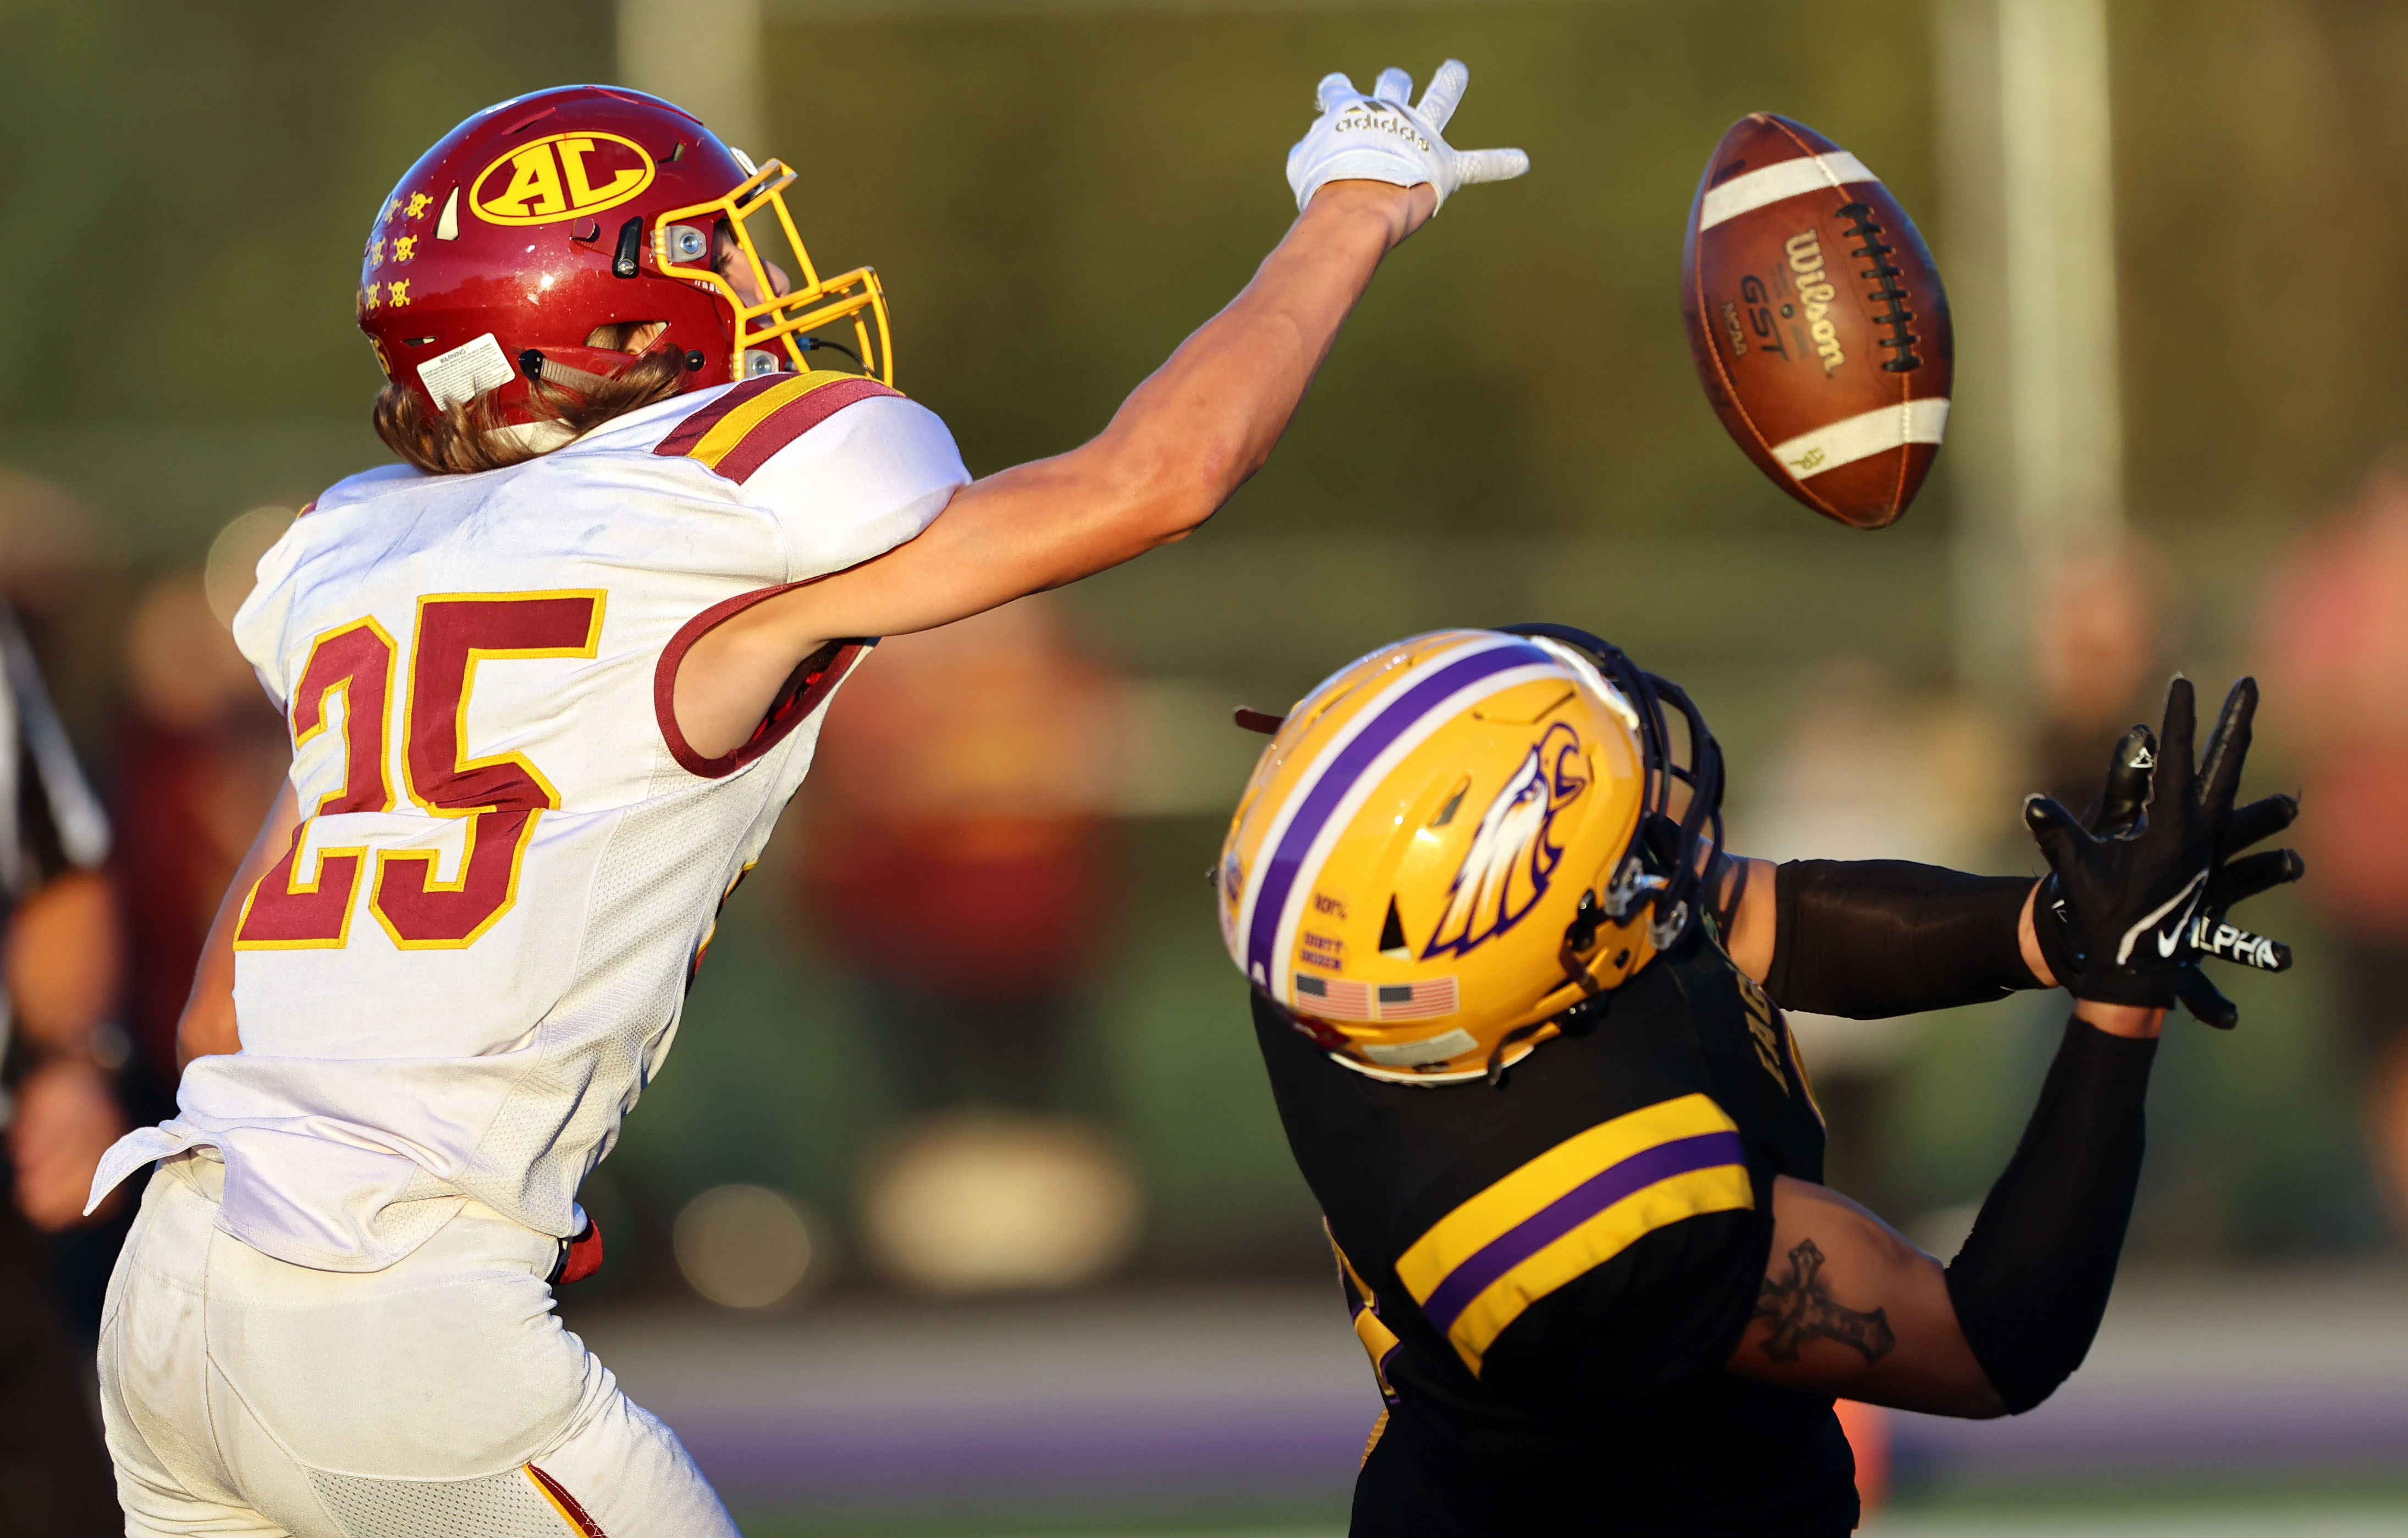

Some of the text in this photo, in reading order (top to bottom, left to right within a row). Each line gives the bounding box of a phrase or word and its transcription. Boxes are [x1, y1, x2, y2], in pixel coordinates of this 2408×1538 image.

[1335, 113, 1430, 153] adidas
[481, 138, 646, 217] AL
[1721, 302, 1748, 358] NCAA
[1740, 274, 1789, 361] GST
[1784, 227, 1845, 373] Wilson
[439, 348, 466, 364] WARNING
[233, 589, 608, 951] 25
